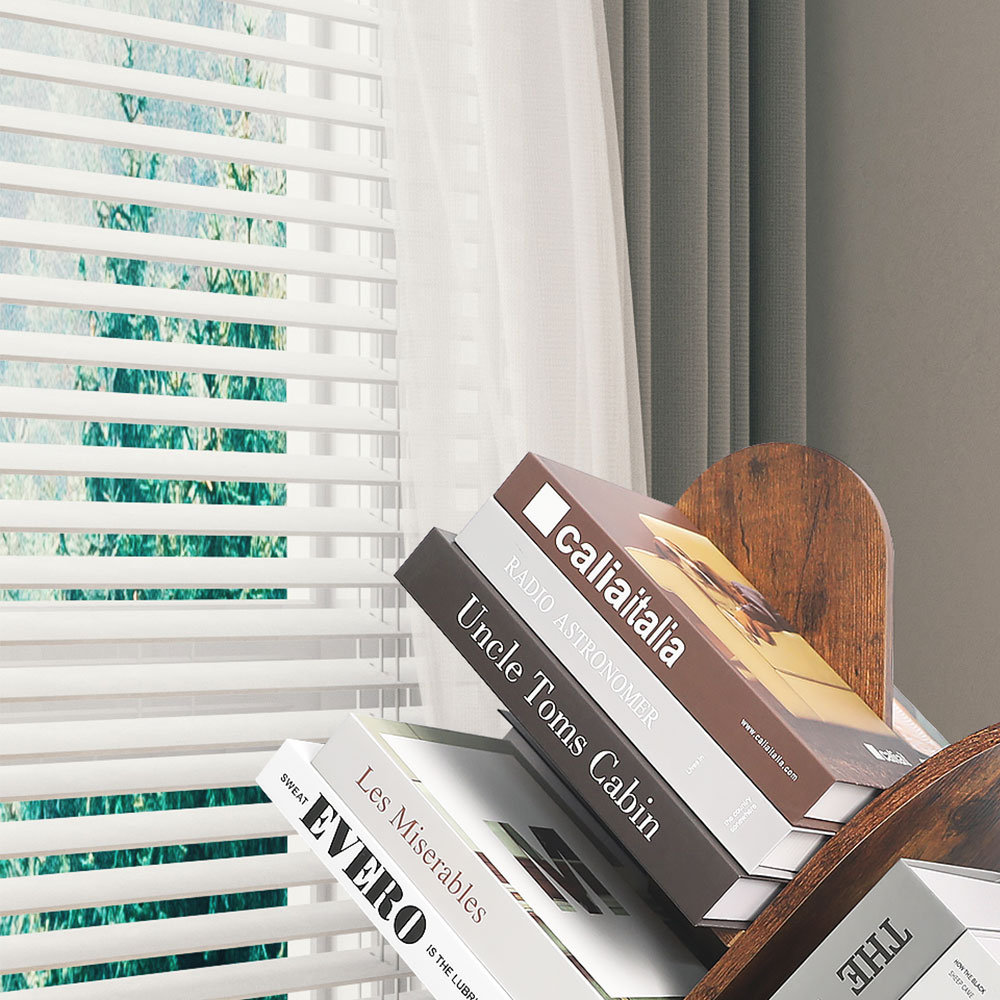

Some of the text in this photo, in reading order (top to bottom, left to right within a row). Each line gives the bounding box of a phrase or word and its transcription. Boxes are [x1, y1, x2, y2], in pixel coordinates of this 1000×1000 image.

[504, 555, 660, 731] RADIO ASTRONOMER
[555, 525, 686, 669] caliaitalia
[280, 773, 309, 806] SWEAT
[457, 592, 661, 842] Uncle Toms Cabin
[299, 792, 427, 945] EVERO
[355, 765, 487, 925] Les Miserables
[426, 944, 437, 957] IS
[436, 954, 454, 977] THE
[836, 917, 914, 996] THE
